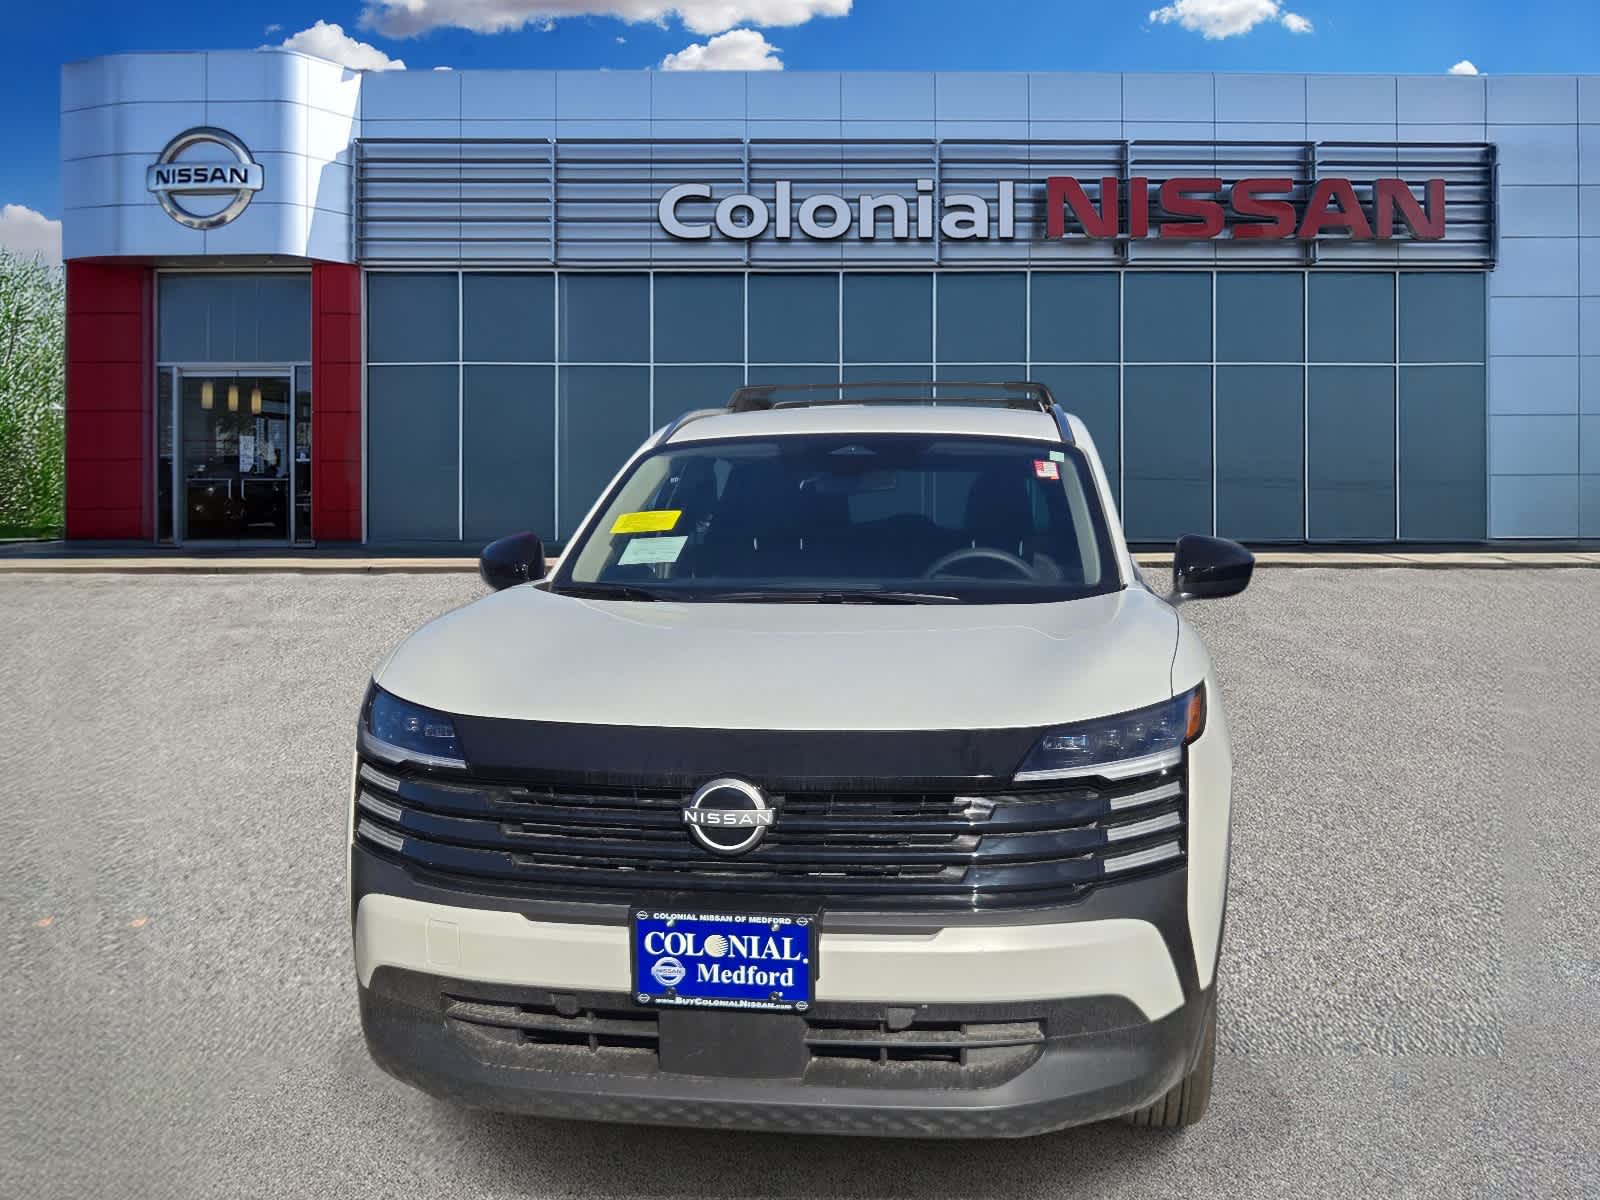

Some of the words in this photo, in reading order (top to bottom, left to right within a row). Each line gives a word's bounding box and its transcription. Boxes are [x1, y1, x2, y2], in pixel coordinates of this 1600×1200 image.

[155, 166, 249, 186] NISSAN
[658, 179, 1015, 240] Colonial
[1045, 176, 1446, 241] NISSAN
[684, 810, 772, 825] NISSAN
[653, 912, 698, 921] COLONIAL
[699, 914, 733, 922] NISSAN
[734, 915, 747, 923] OF
[748, 916, 792, 925] MEDFORD
[696, 963, 794, 986] Medford
